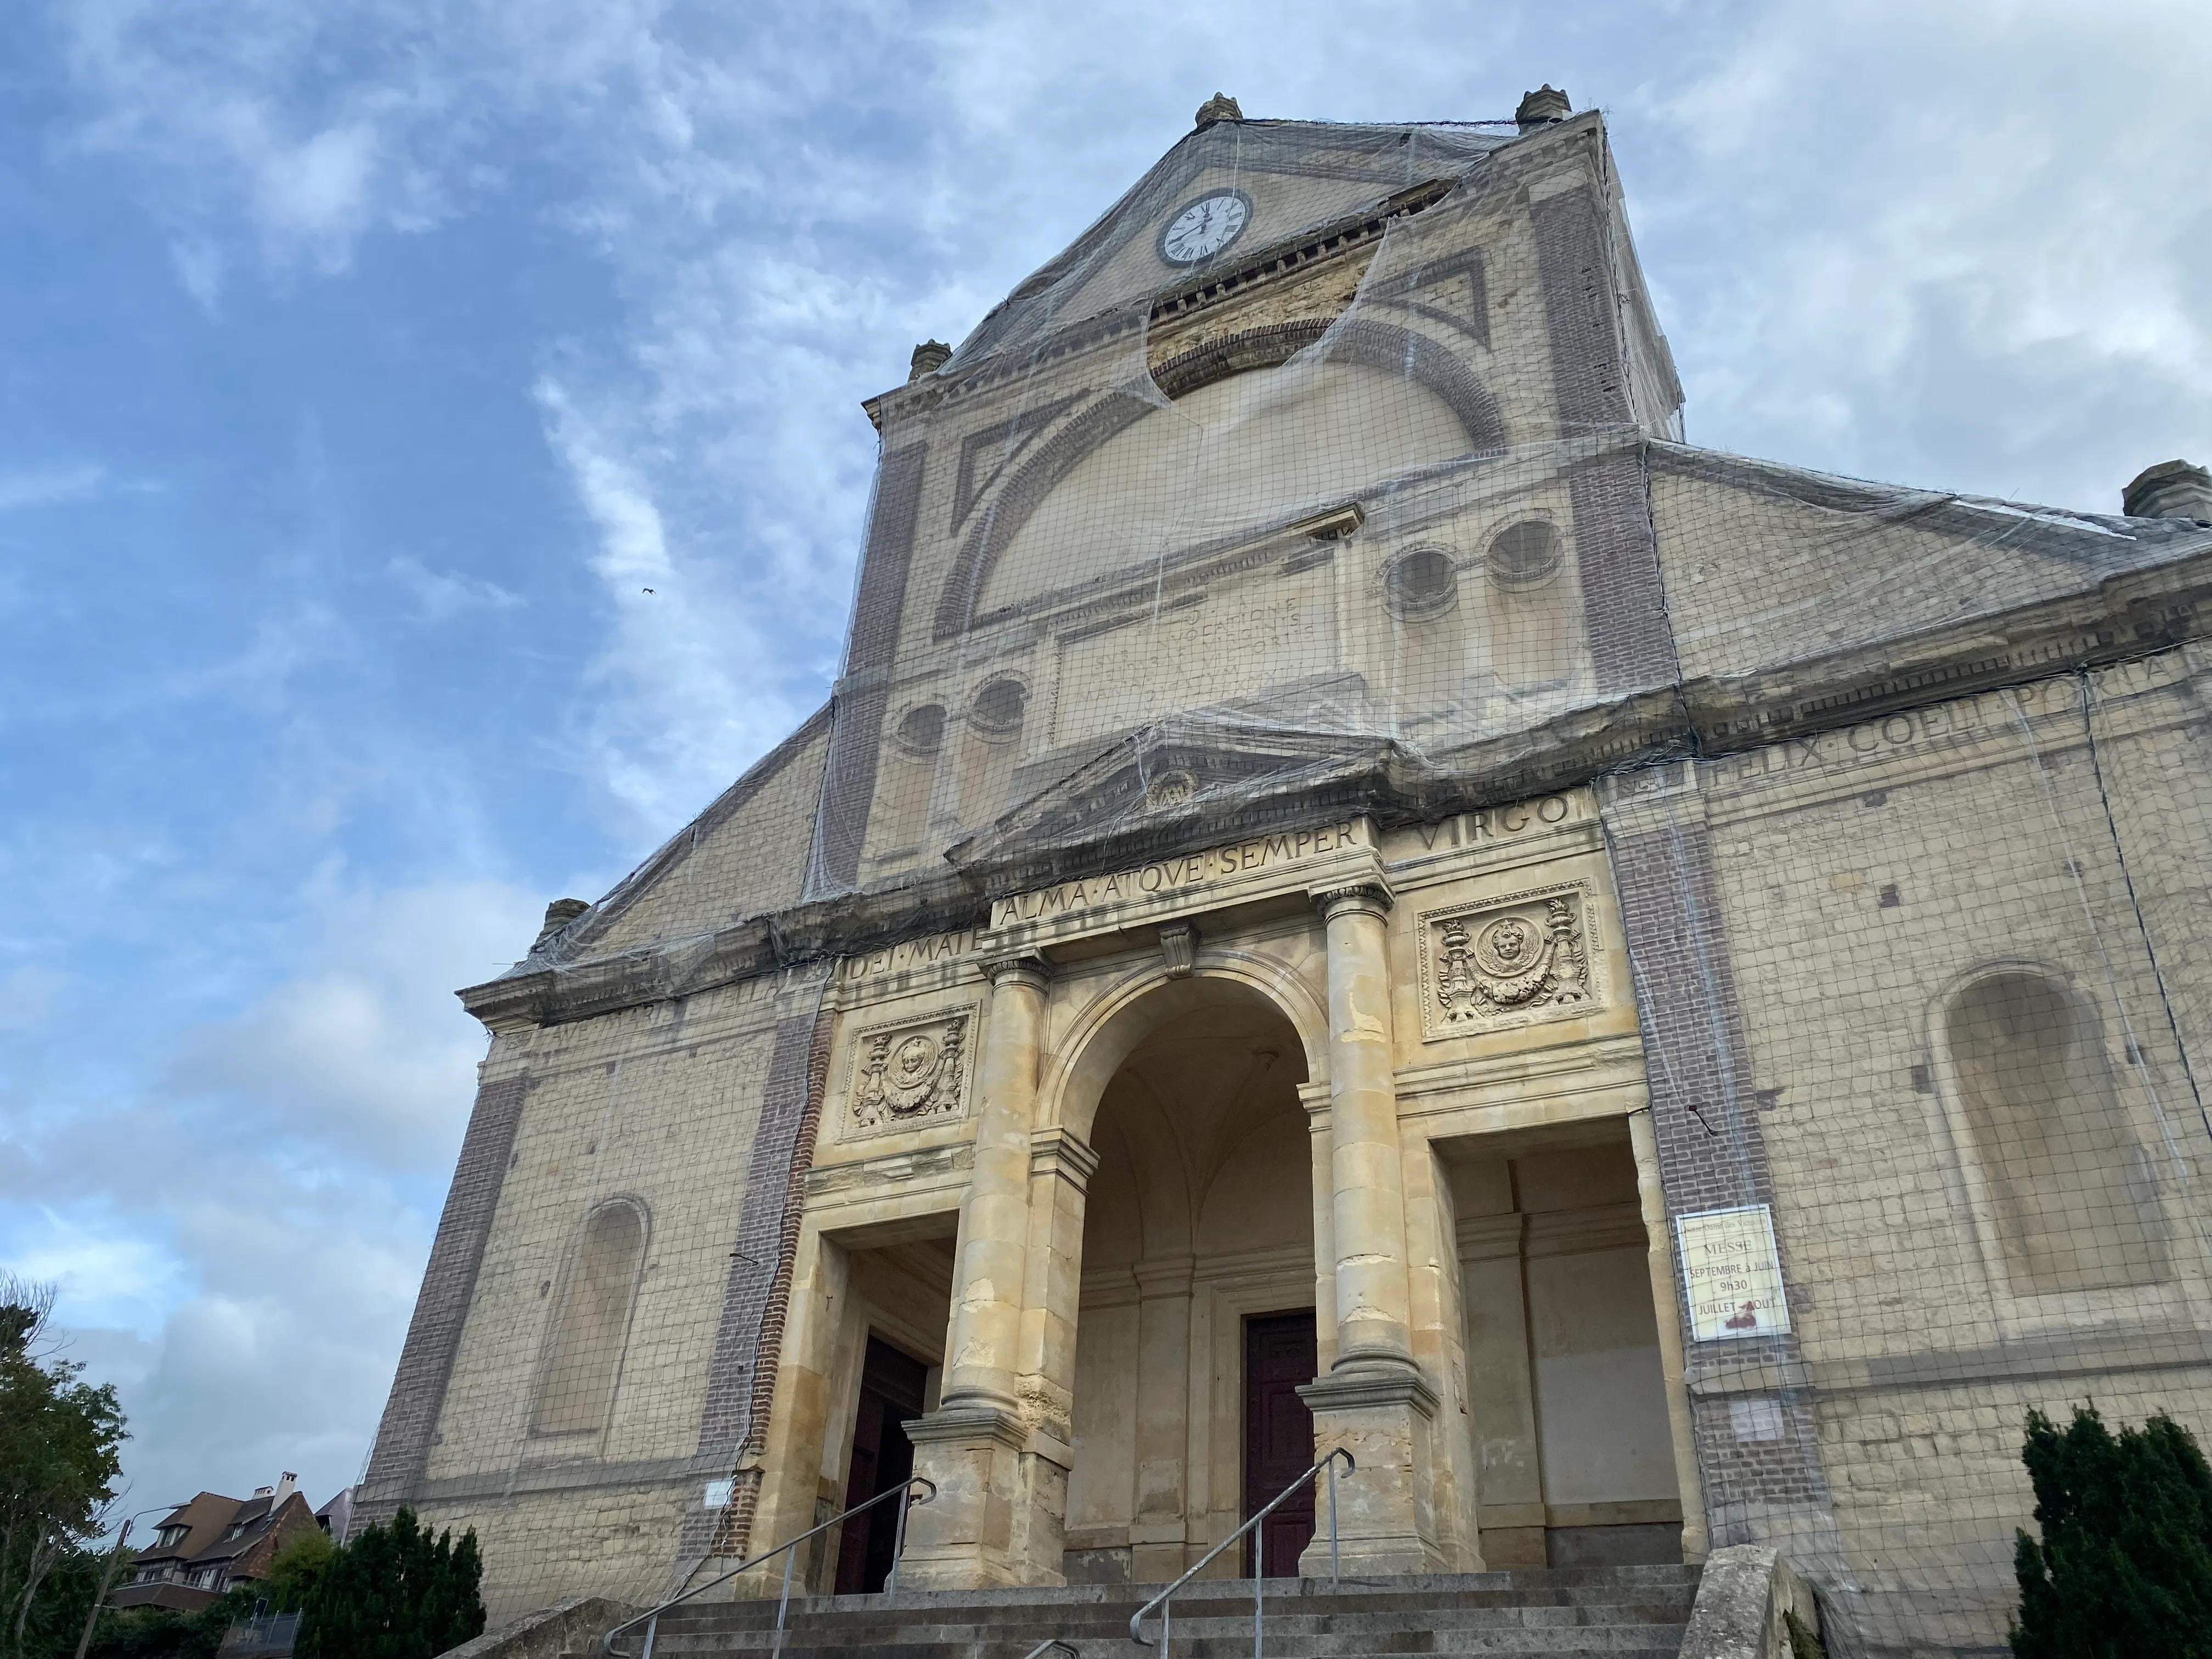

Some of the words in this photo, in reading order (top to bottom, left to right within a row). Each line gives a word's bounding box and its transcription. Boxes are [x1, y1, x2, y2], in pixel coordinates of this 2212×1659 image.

[1154, 597, 1296, 650] NVOCATIONE
[1847, 698, 1988, 752] COELI
[1417, 795, 1570, 851] VIRGO
[998, 883, 1090, 926] ALMA
[1101, 855, 1204, 902] ATQVE
[1220, 822, 1357, 875] SEMPER
[850, 947, 895, 980] DEI
[907, 927, 983, 966] MATE
[1690, 1263, 1742, 1279] SEPTEMBRE
[1754, 1261, 1774, 1272] JUIN
[1704, 1240, 1753, 1256] MESSE
[1699, 1301, 1736, 1315] JUILLET
[1720, 1279, 1748, 1292] 9h30
